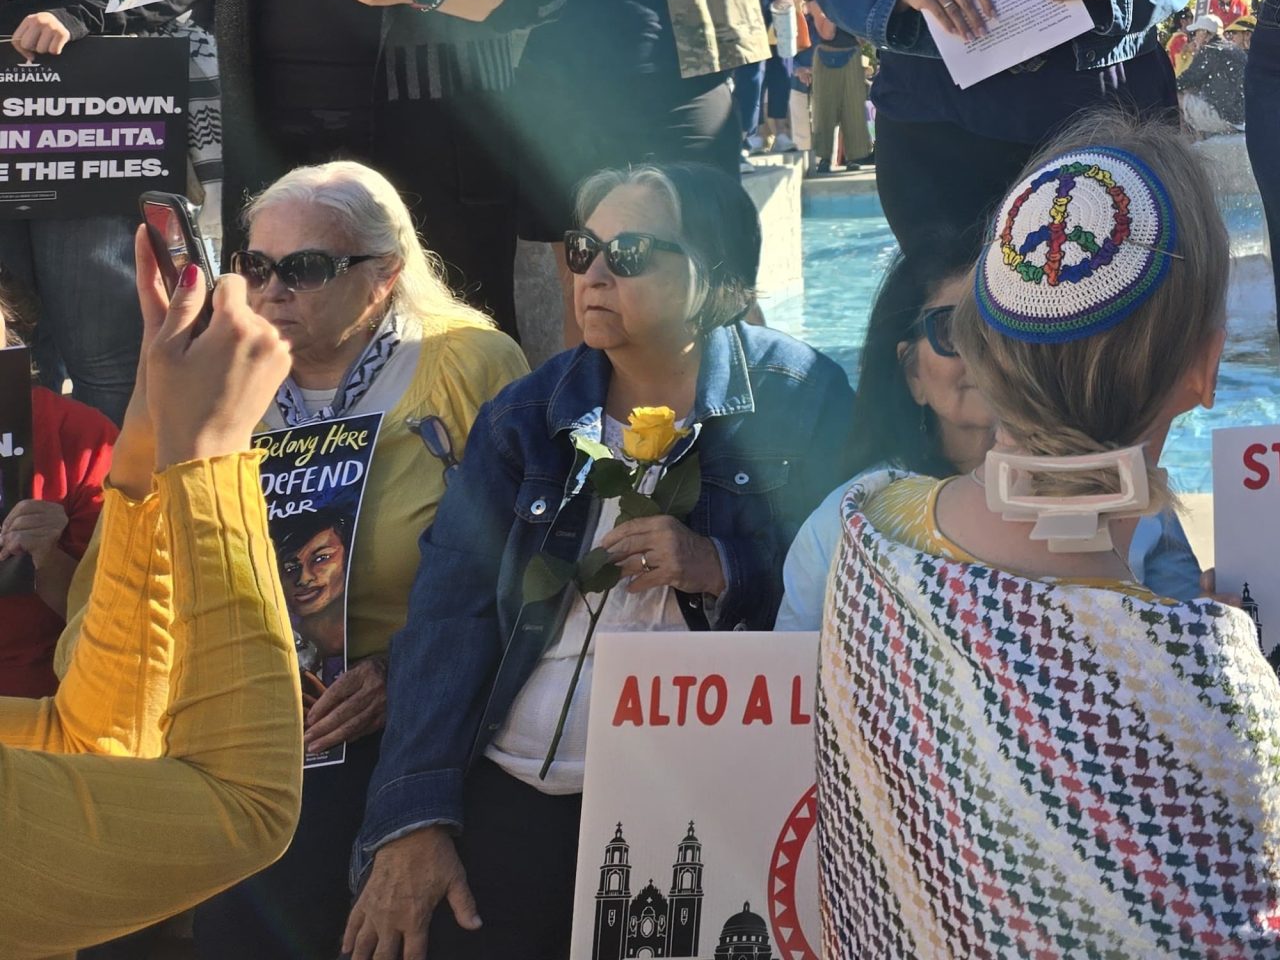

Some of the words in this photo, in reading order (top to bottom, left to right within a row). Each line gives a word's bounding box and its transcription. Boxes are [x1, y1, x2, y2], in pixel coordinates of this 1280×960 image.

[3, 96, 182, 117] SHUTDOWN.
[36, 127, 164, 148] ADELITA.
[15, 161, 75, 181] THE
[82, 158, 169, 179] FILES.
[612, 674, 728, 727] ALTO
[742, 674, 773, 726] A
